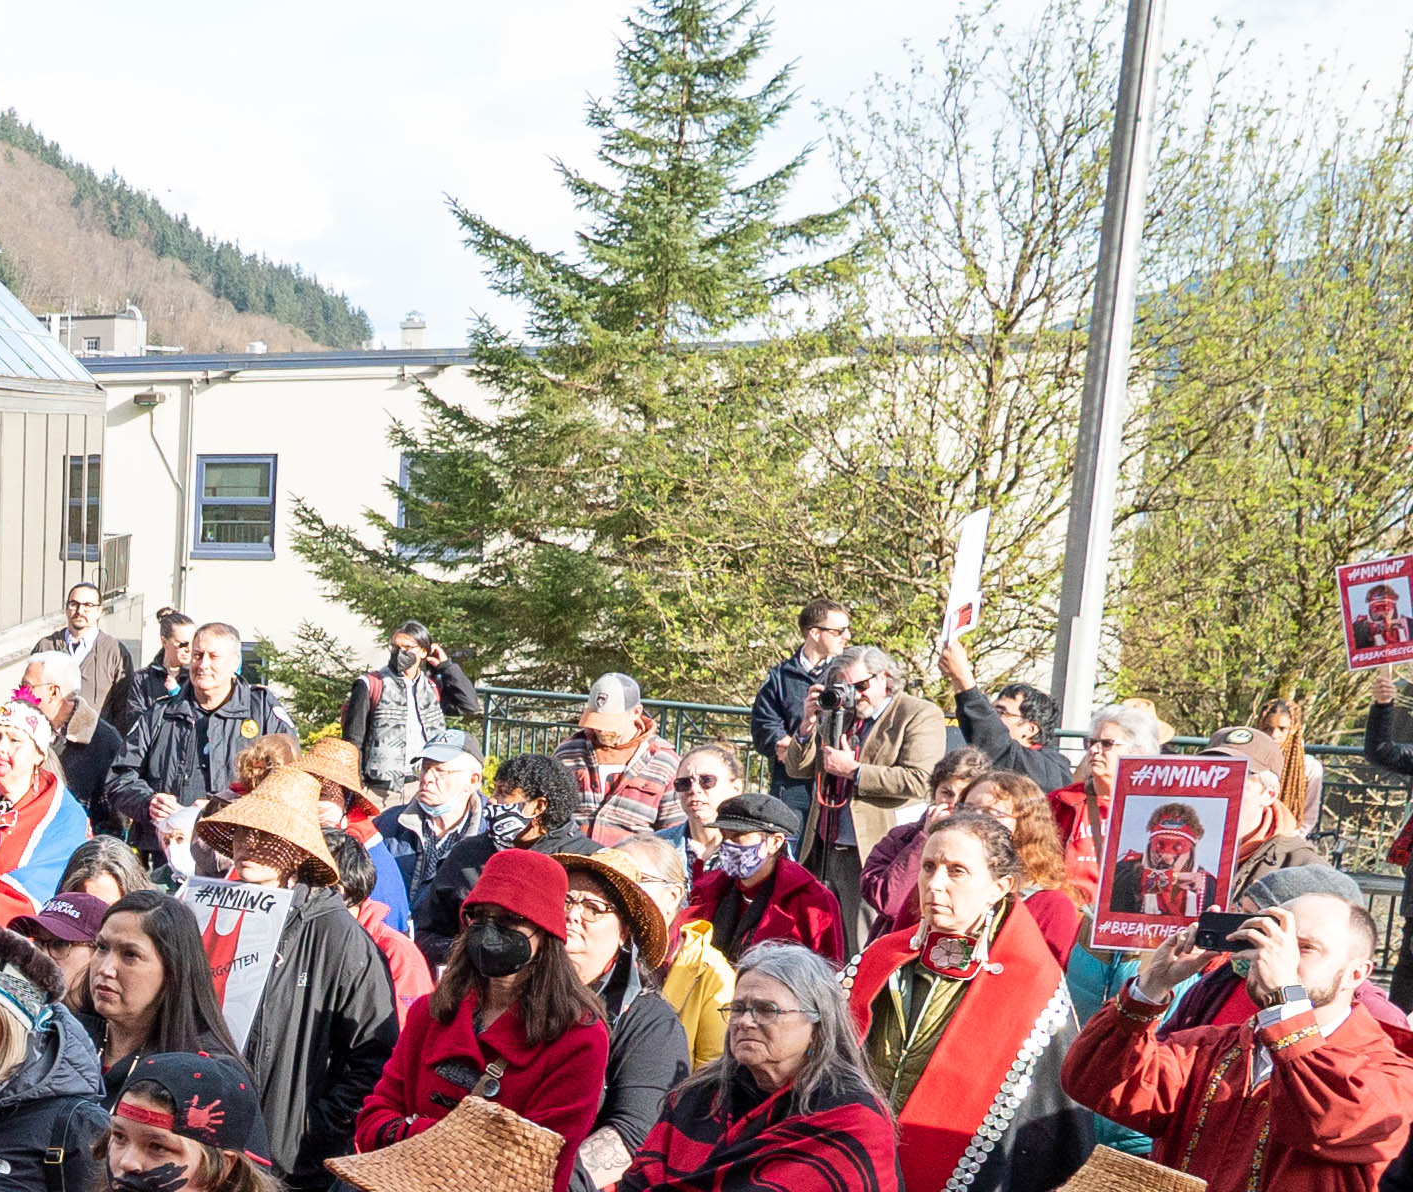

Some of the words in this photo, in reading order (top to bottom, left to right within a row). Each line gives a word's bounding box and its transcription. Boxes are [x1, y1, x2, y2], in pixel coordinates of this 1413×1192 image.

[1347, 560, 1405, 581] #MMIWP
[1130, 765, 1230, 788] #MMIWP
[195, 885, 276, 914] #MMIWG
